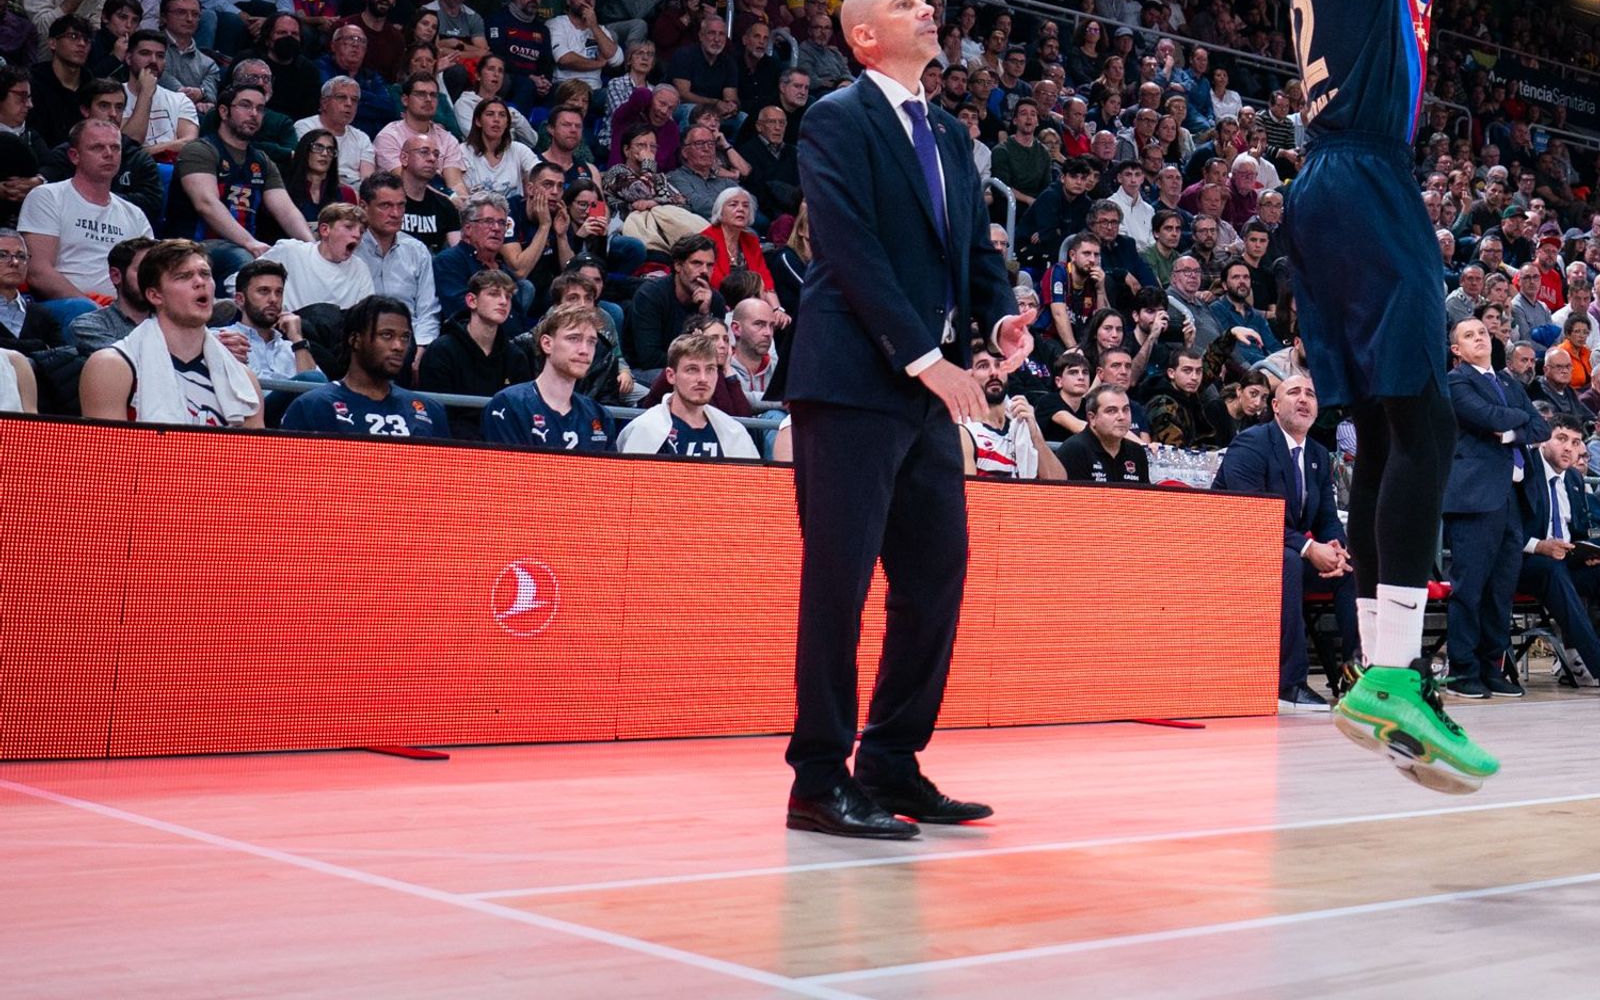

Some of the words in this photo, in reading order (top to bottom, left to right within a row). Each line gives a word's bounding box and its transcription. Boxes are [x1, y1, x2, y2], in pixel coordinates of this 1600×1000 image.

[509, 44, 540, 58] QATAR
[75, 218, 98, 232] JEAN
[101, 222, 124, 236] PAUL
[85, 231, 116, 243] FRANCE
[365, 413, 410, 437] 23
[563, 431, 579, 449] 2
